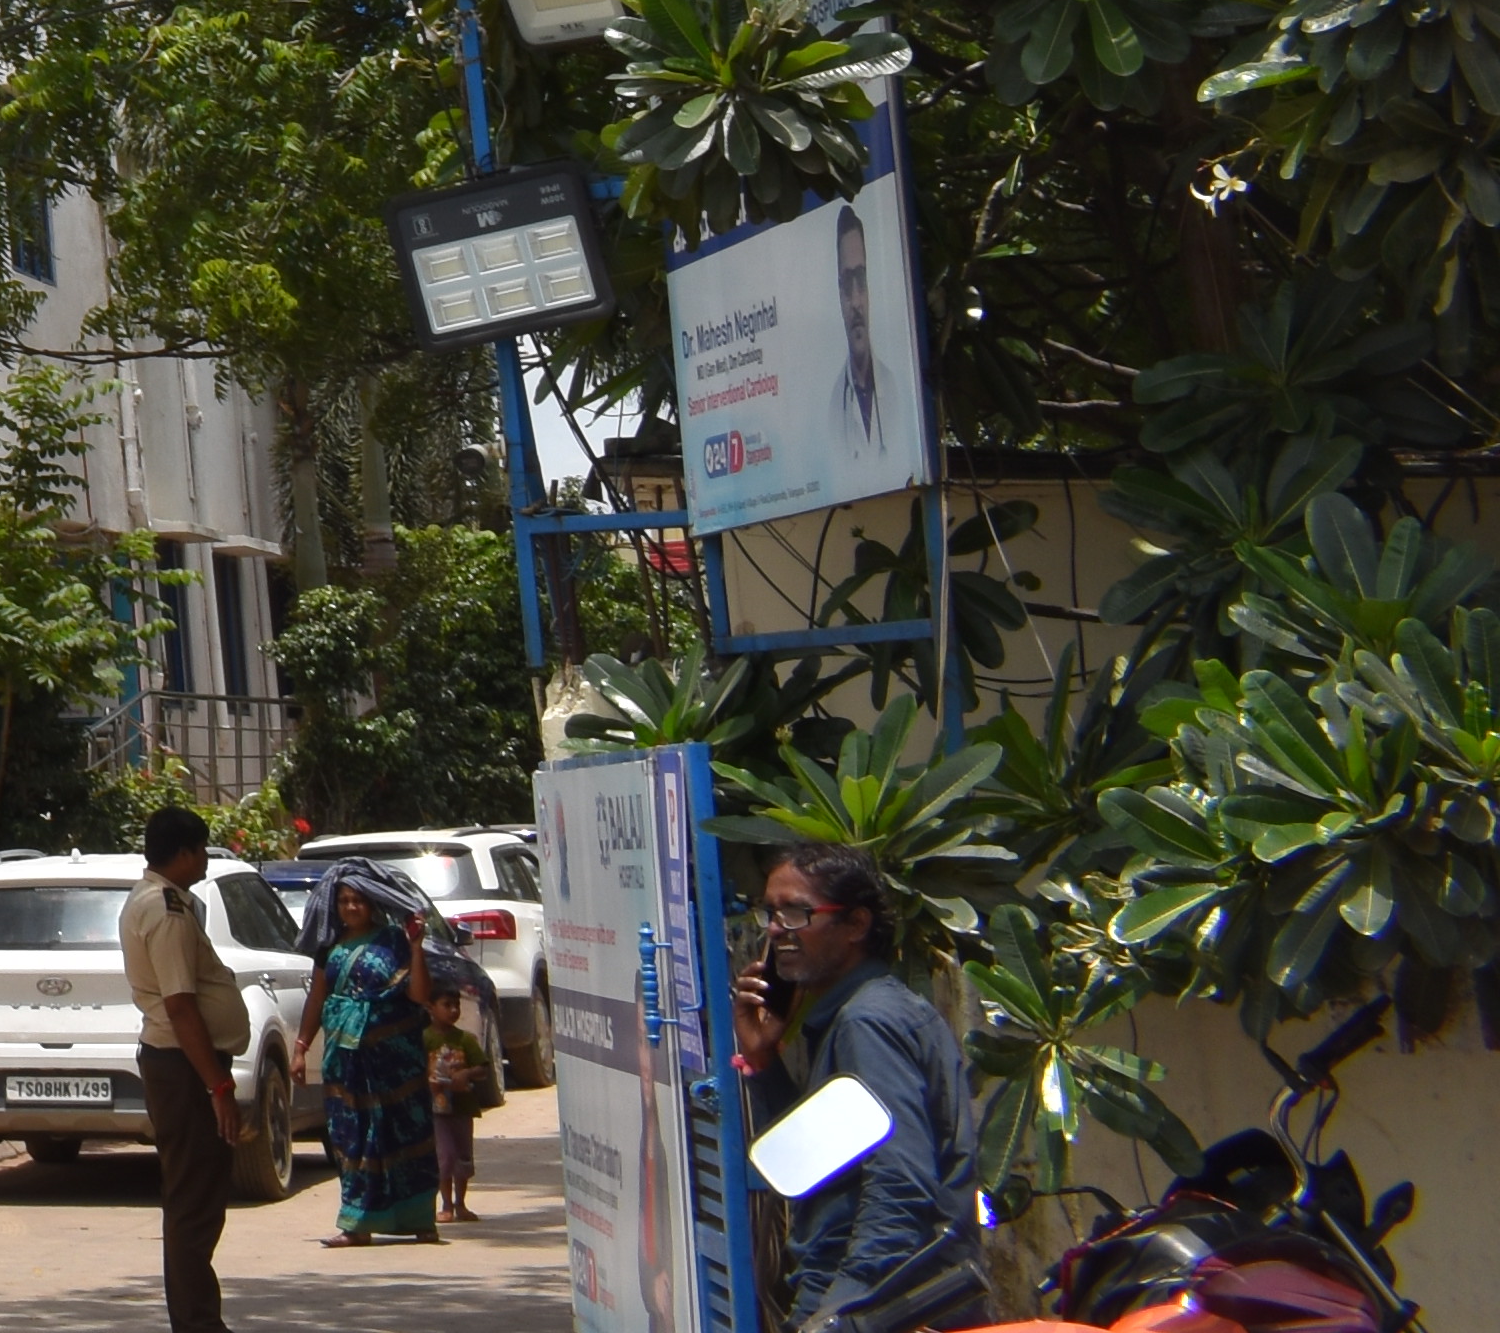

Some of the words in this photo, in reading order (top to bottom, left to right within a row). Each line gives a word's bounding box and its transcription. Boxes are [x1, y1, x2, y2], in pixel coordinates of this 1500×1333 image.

[682, 330, 696, 359] Dr.
[696, 315, 735, 353] Mahesh
[735, 296, 778, 343] Neginhal
[688, 394, 706, 417] Senior
[706, 382, 745, 413] Interventional
[746, 374, 779, 400] Cardiology
[713, 443, 726, 471] 24
[731, 437, 738, 466] 7
[607, 793, 647, 852] BALAJI
[668, 788, 676, 847] P
[576, 1008, 614, 1052] HOSPITALS
